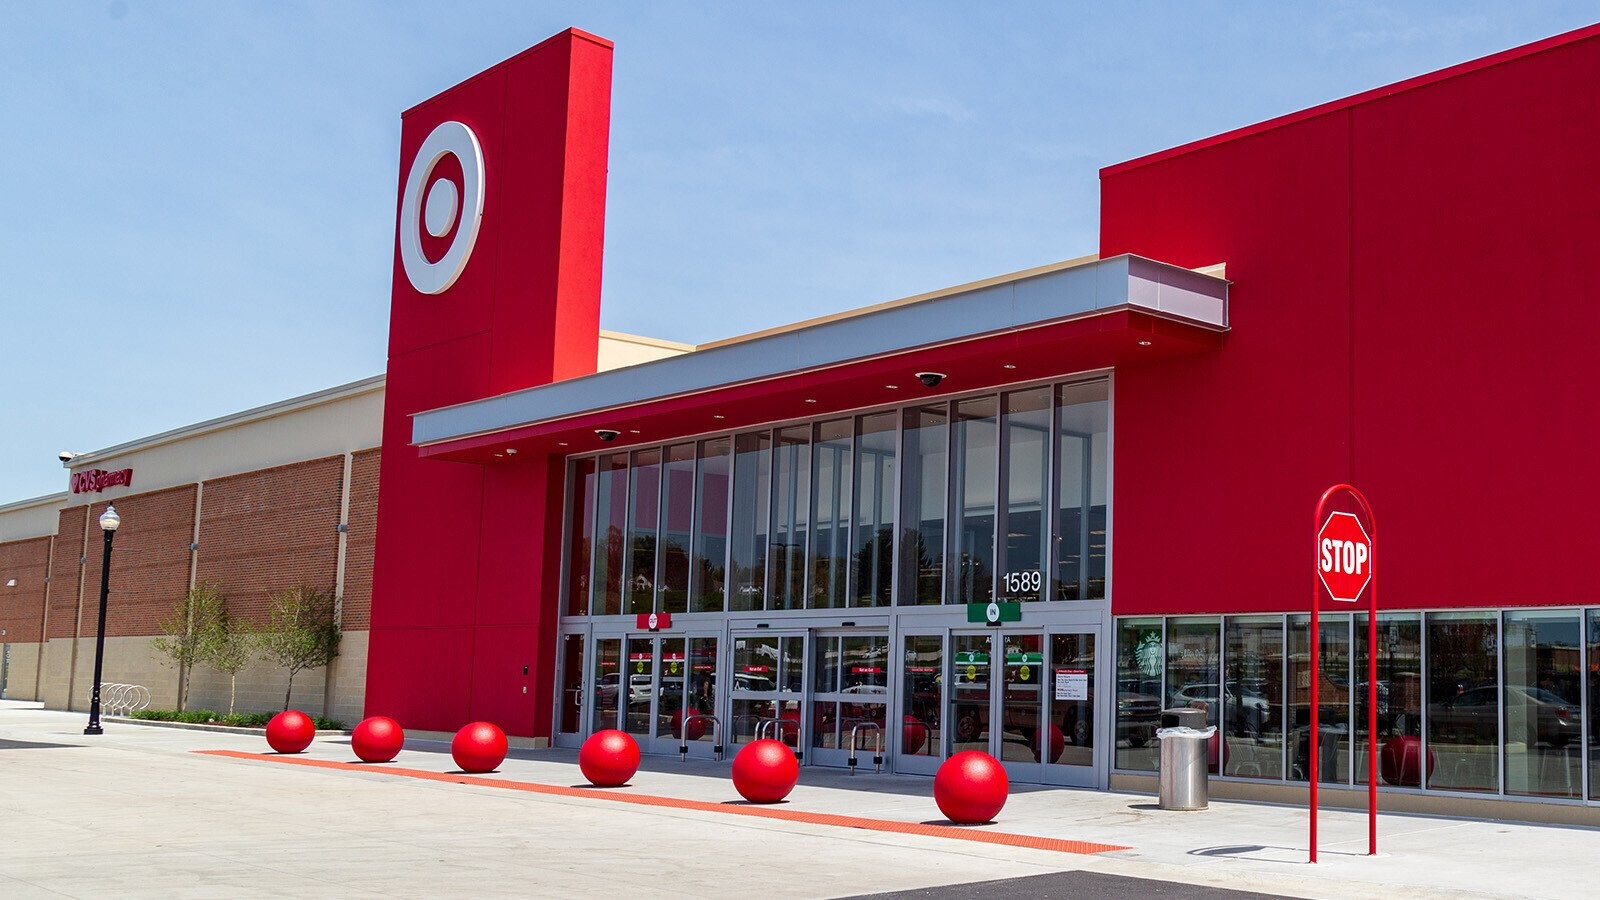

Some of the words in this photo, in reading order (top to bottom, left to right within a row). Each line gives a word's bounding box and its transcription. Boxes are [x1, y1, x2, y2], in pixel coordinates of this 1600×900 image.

[79, 469, 98, 492] CVS
[1322, 538, 1367, 574] STOP
[1003, 571, 1041, 592] 1589
[990, 608, 997, 616] IN
